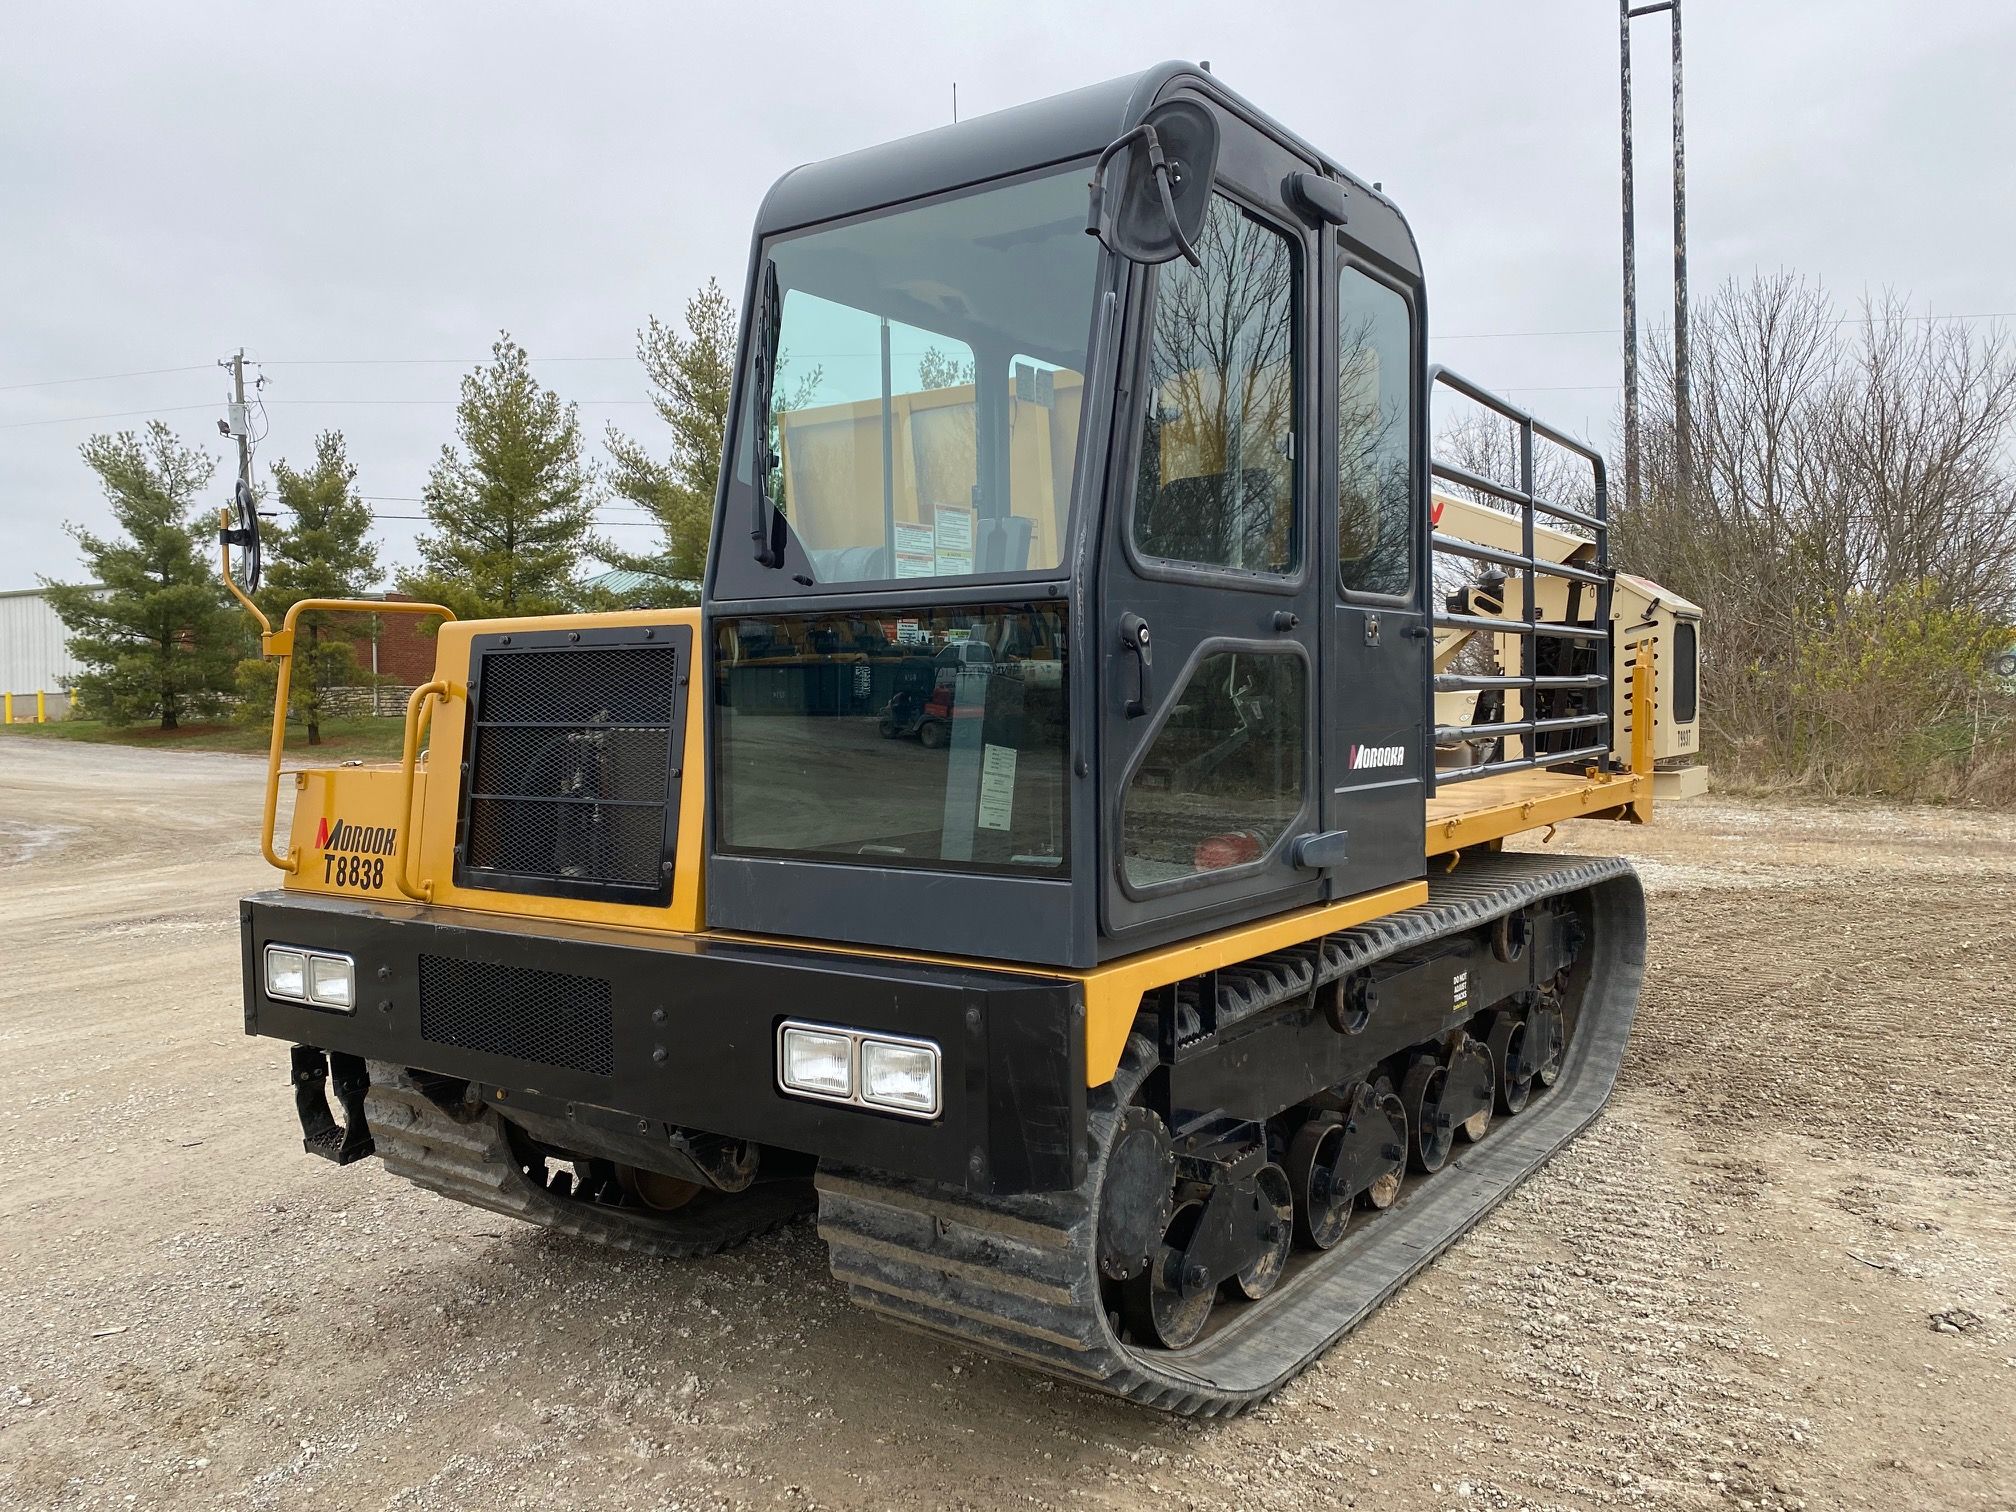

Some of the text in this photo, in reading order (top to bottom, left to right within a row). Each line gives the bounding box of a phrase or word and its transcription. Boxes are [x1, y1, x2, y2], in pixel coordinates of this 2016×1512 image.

[1348, 744, 1405, 770] MOROOKA
[315, 817, 398, 857] MOROOK
[324, 853, 384, 890] T8838
